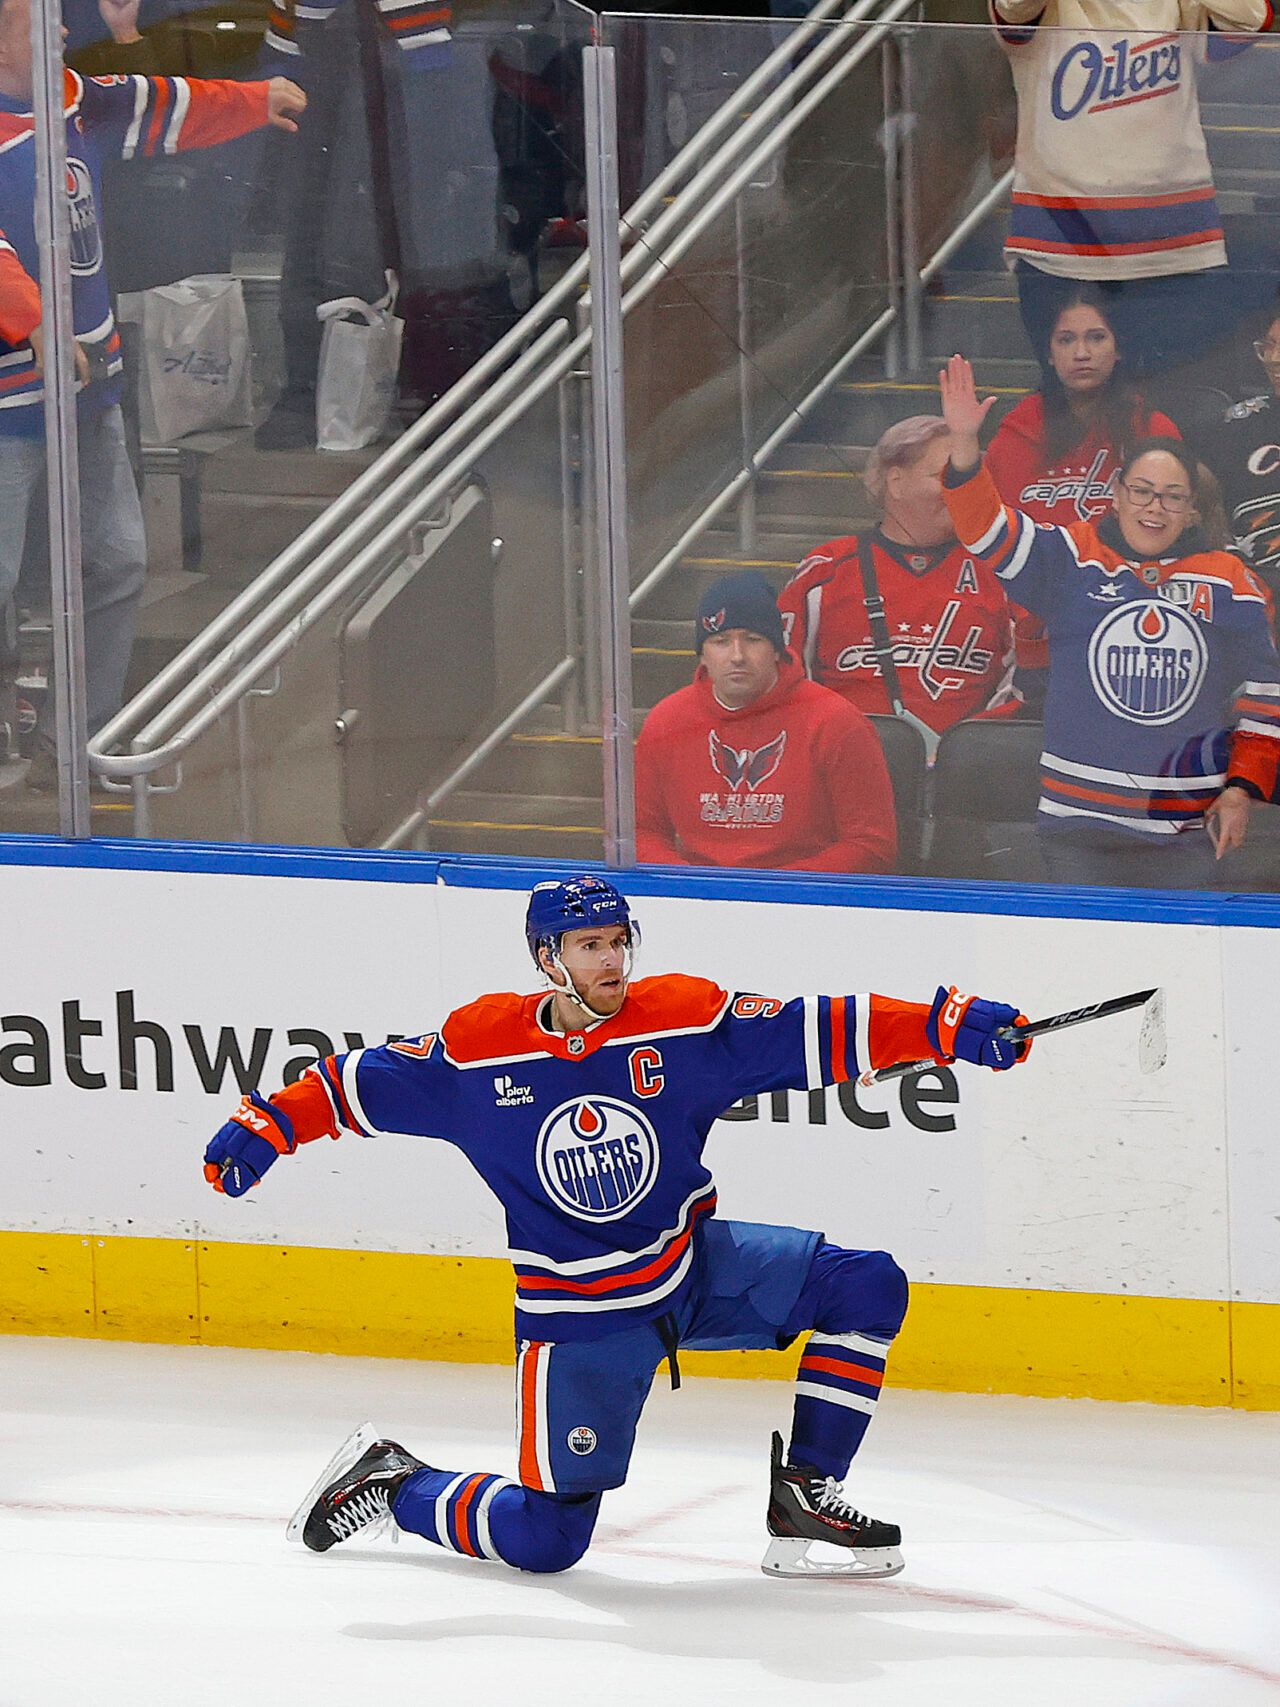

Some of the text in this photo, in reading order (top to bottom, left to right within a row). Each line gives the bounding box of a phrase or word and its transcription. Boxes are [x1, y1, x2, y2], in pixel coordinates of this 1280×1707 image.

[1051, 38, 1181, 121] Oilers
[954, 558, 979, 594] A
[1187, 582, 1214, 624] A
[1107, 644, 1193, 692] OILERS
[592, 899, 617, 912] CCM
[506, 1085, 531, 1099] play
[628, 1045, 665, 1099] C
[495, 1094, 535, 1107] alberta
[553, 1132, 644, 1194] OILERS
